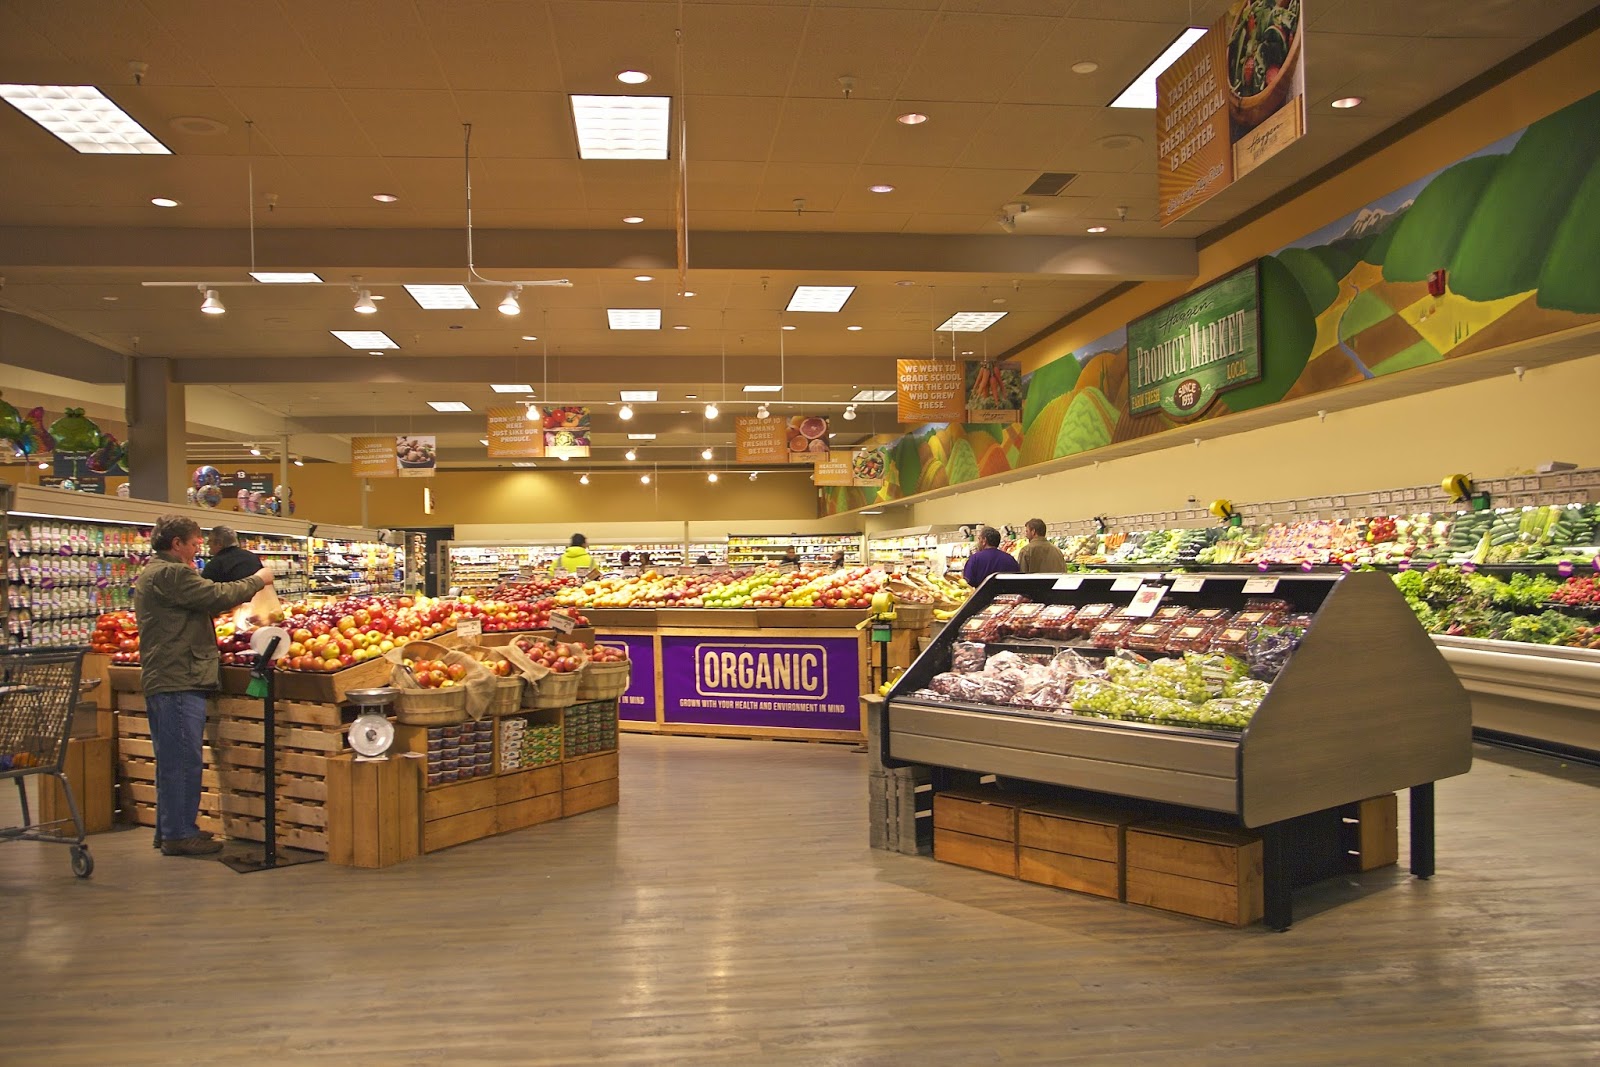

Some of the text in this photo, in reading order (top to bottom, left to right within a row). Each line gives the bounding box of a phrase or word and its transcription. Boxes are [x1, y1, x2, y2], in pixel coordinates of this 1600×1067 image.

[1168, 54, 1211, 106] TASTE THE
[1160, 123, 1186, 159] FRESH
[1197, 89, 1225, 126] LOCAL
[1171, 151, 1179, 172] IS
[1180, 123, 1216, 164] BETTER.
[1159, 301, 1214, 335] Haggen
[1137, 309, 1244, 388] PRODUCE MARKET
[904, 364, 956, 373] WE WENT TO
[1226, 359, 1248, 380] LOCAL
[900, 373, 962, 382] GRADE SCHOOL
[902, 382, 961, 391] WITH THE GUY
[1177, 382, 1197, 398] SINCE
[908, 391, 955, 400] WHO GREW
[1131, 387, 1160, 410] FARM FRESH
[1181, 393, 1194, 407] 1933
[237, 471, 246, 479] 13
[704, 651, 818, 691] ORGANIC
[621, 695, 629, 704] IN
[630, 696, 645, 705] MIND
[679, 698, 845, 714] GROWN WITH YOUR HEALTH AND ENVIRONMENT IN MIND
